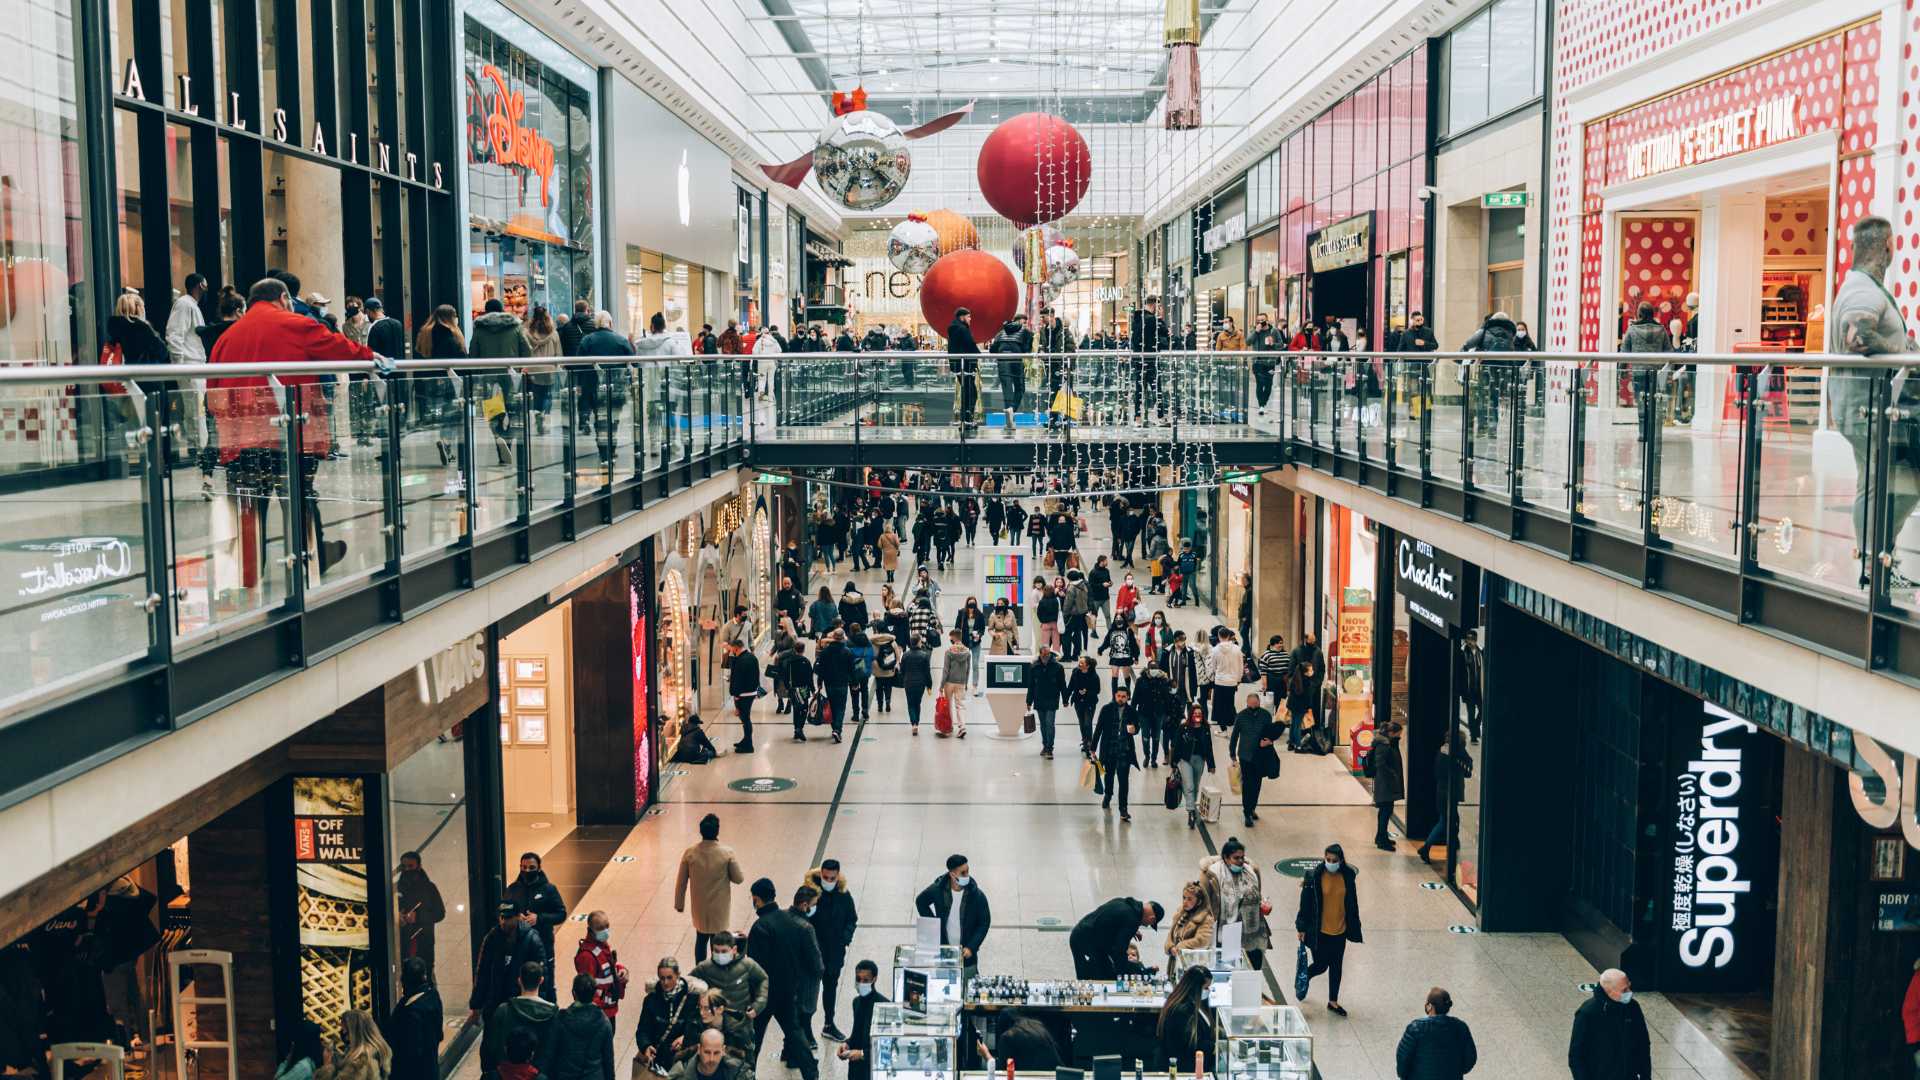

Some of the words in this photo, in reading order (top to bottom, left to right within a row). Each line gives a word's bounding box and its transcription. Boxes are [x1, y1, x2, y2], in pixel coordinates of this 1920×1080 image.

[121, 57, 443, 190] ALLSAINTS
[1626, 128, 1696, 180] VICTORIA'S
[1695, 107, 1755, 162] SECRET
[1752, 94, 1799, 147] PINK
[318, 834, 344, 845] THE
[1679, 700, 1758, 968] Superdry
